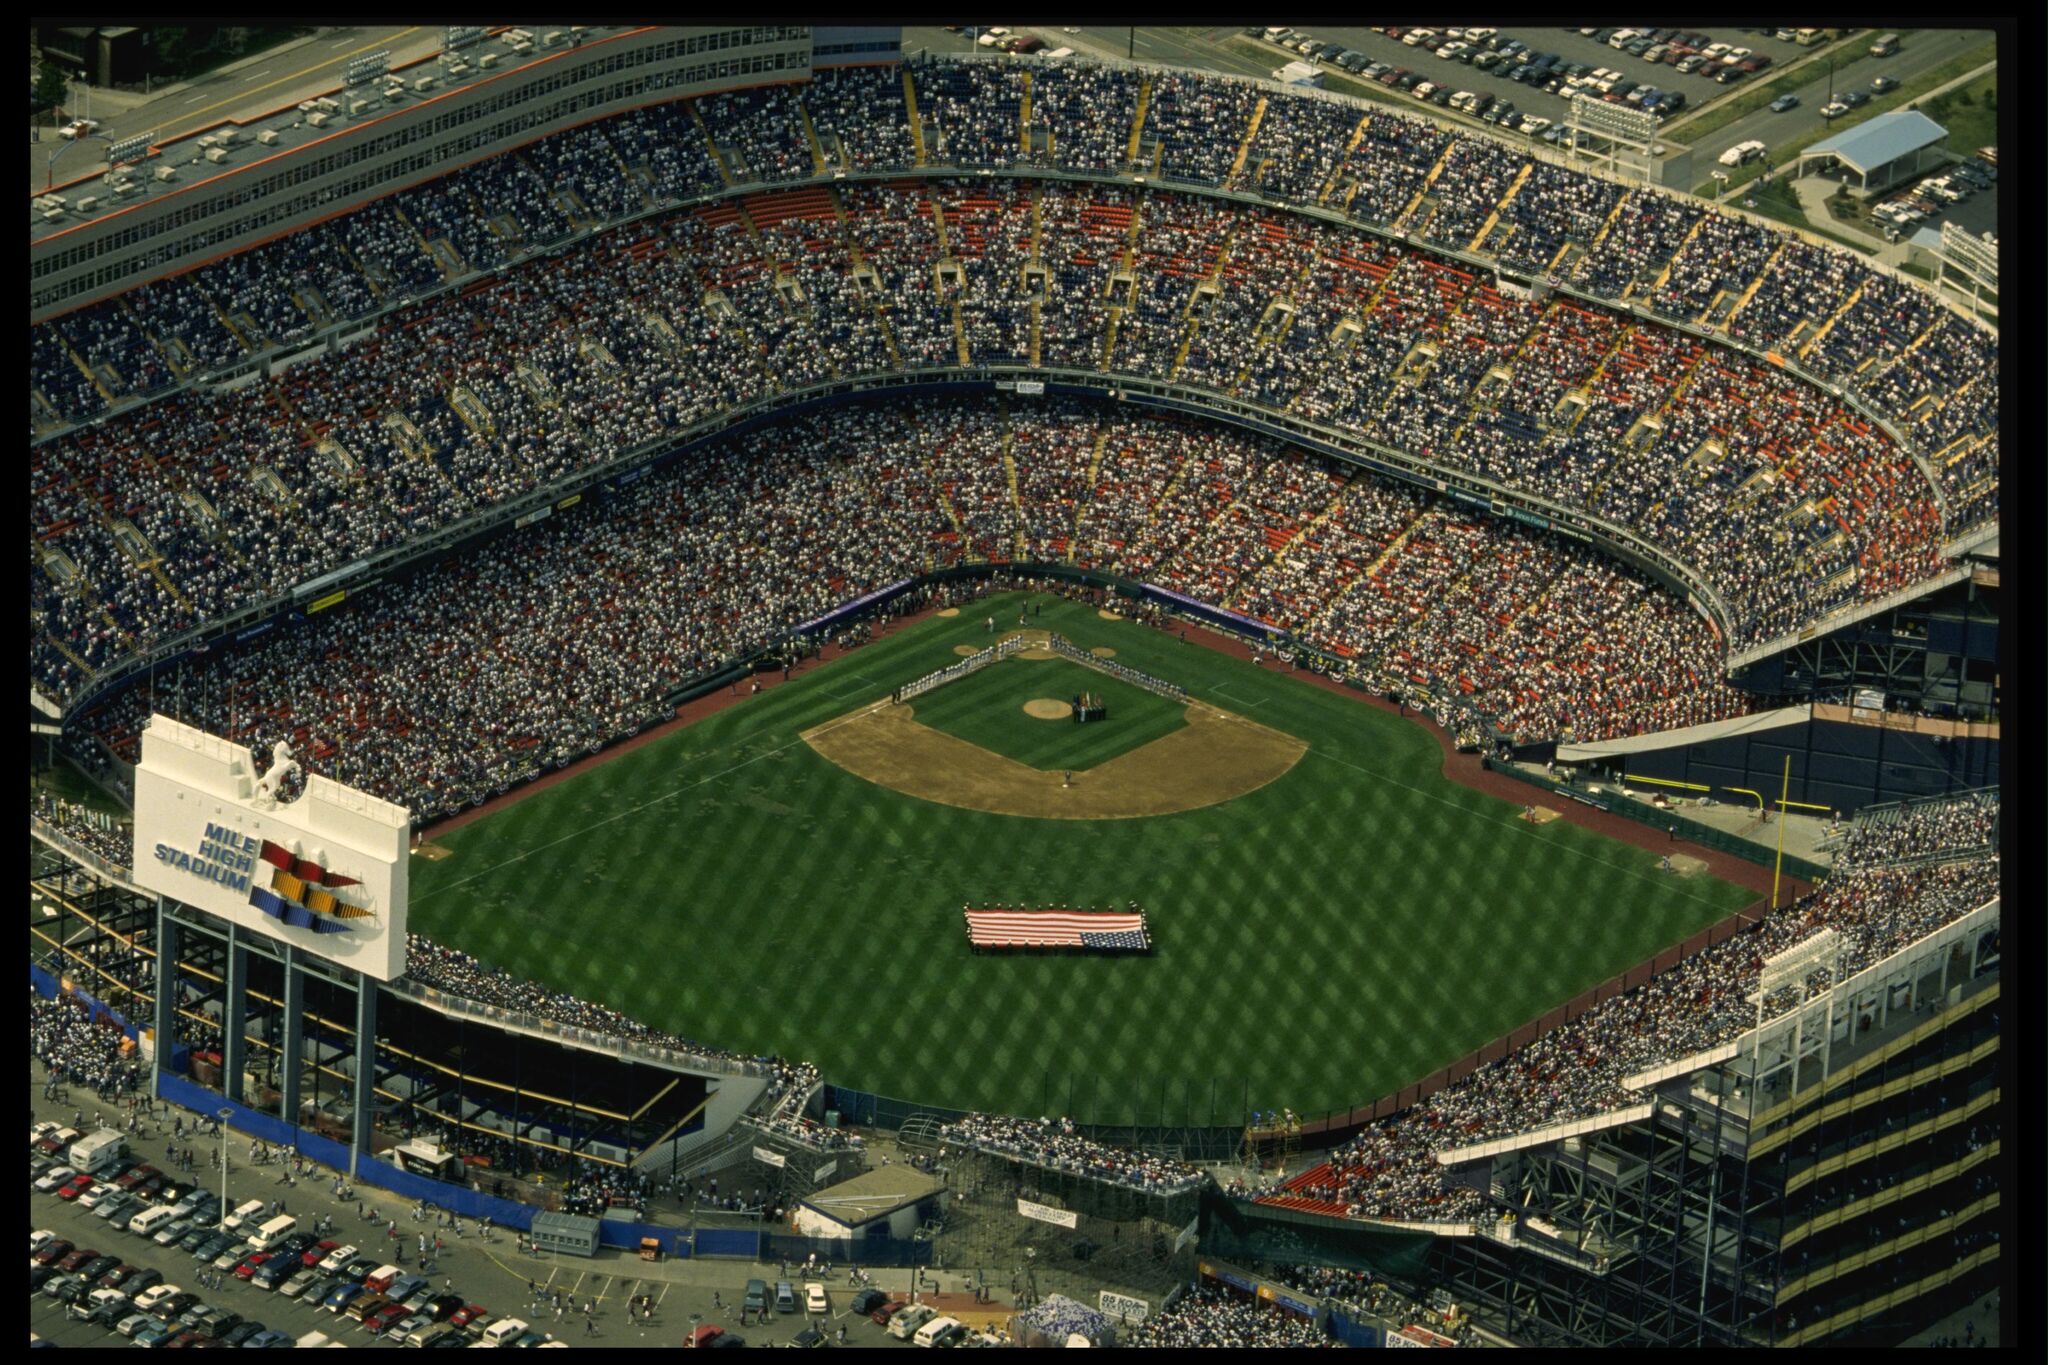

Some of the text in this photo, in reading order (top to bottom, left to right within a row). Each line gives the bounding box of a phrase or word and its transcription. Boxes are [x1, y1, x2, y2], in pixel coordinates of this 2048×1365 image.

[205, 822, 257, 854] MILE
[154, 843, 247, 891] STADIUM
[198, 840, 250, 872] HIGH
[1102, 1294, 1116, 1303] 85
[1389, 1334, 1401, 1344] 85
